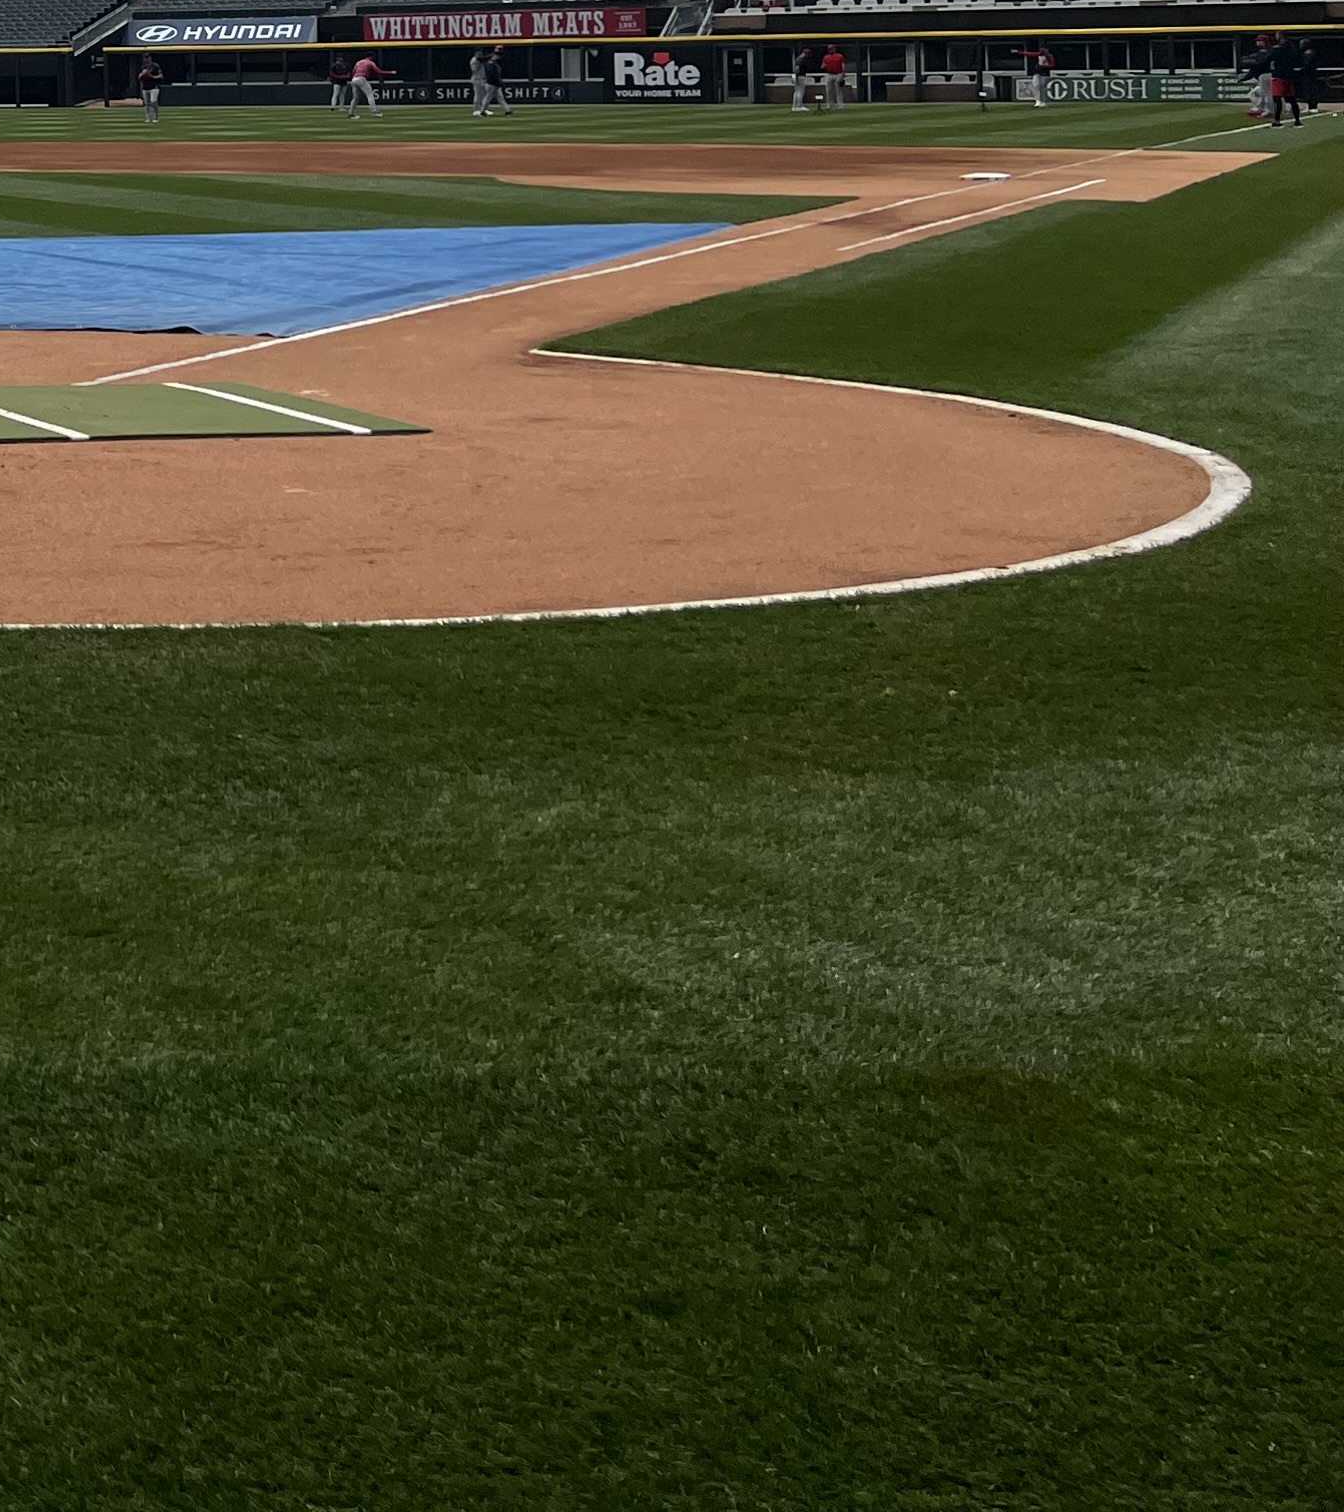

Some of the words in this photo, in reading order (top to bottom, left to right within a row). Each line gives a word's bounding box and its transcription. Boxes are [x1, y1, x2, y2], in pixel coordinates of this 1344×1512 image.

[183, 24, 301, 40] HYUNDAI
[370, 13, 522, 40] WHITTINGHAM
[532, 10, 605, 36] MEATS
[614, 52, 700, 86] Rate
[373, 89, 413, 100] SHIFT
[505, 88, 548, 99] SHIFT
[1072, 79, 1147, 100] RUSH
